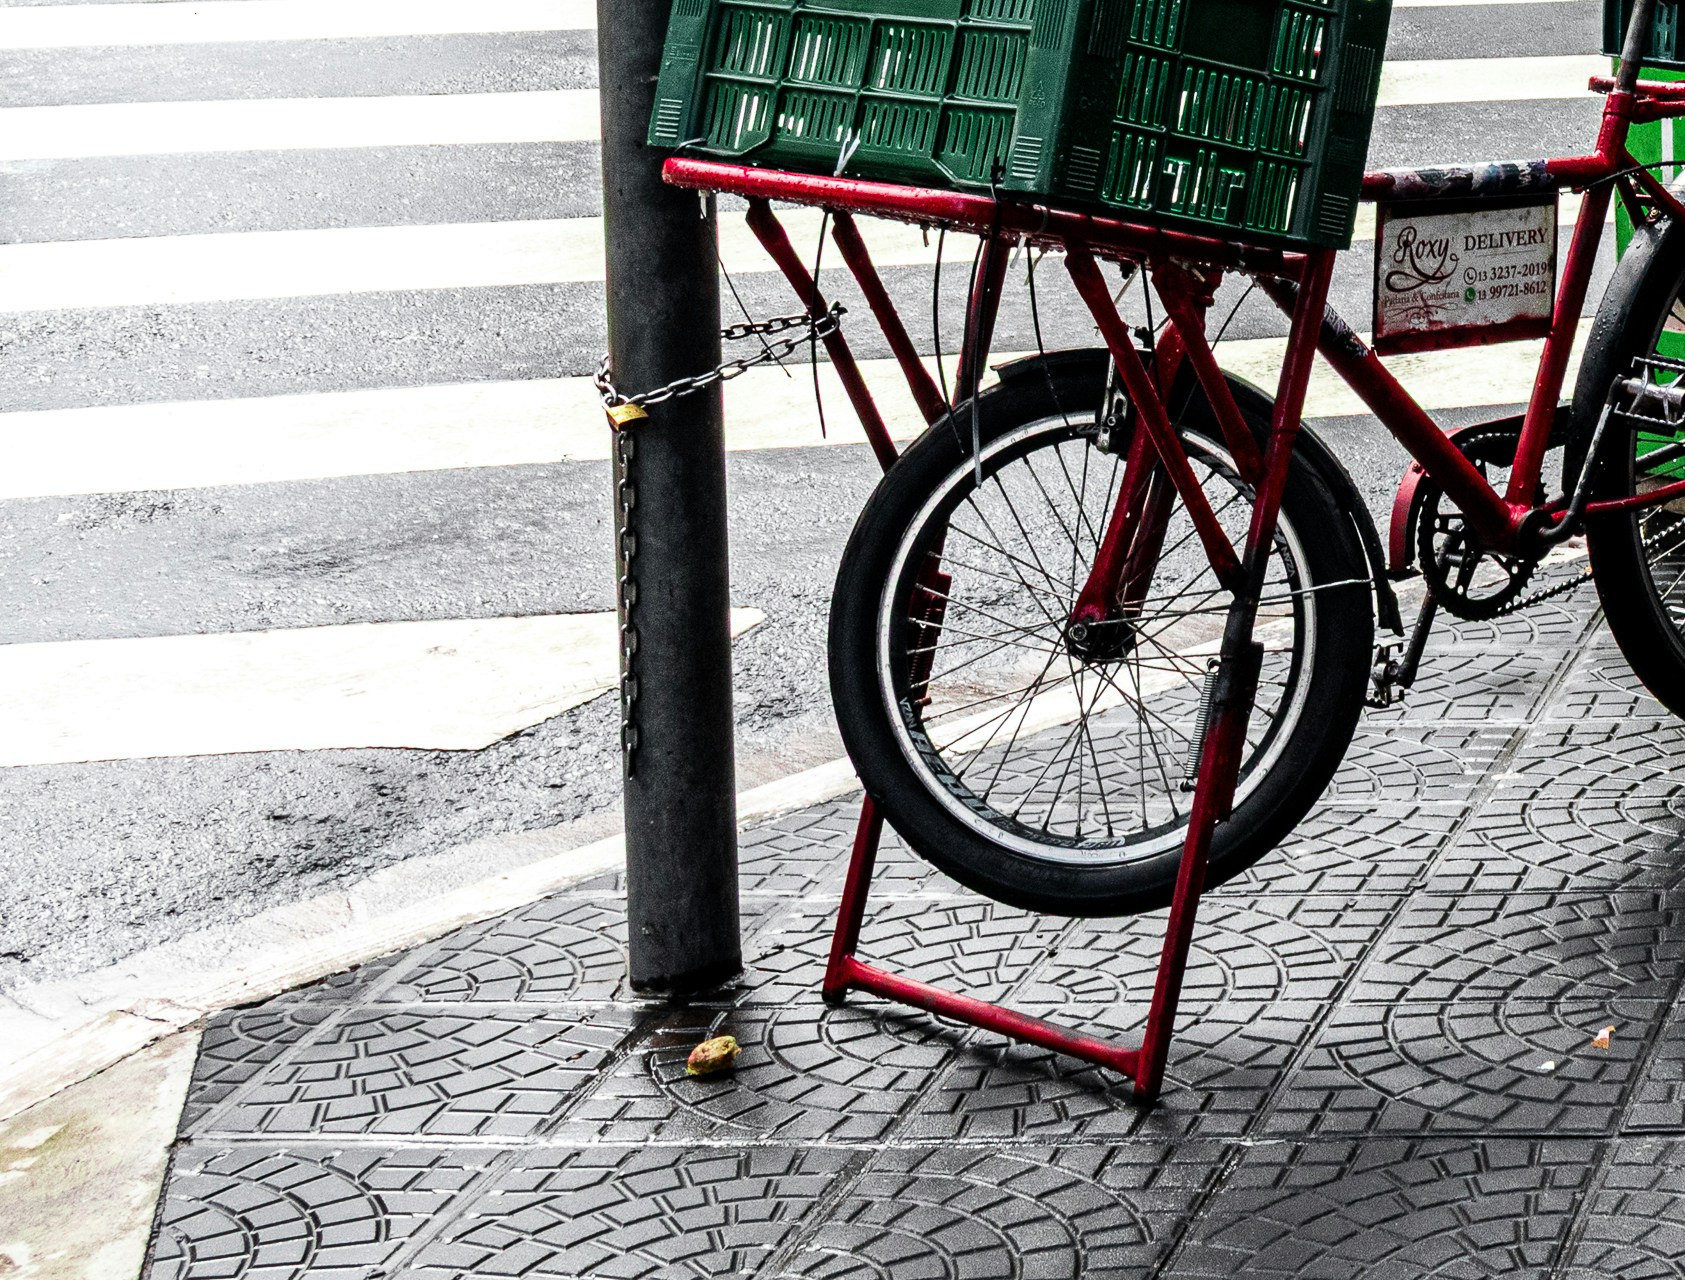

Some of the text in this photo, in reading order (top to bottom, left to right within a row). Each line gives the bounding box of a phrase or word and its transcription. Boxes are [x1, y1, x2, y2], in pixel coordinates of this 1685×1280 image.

[1463, 227, 1549, 252] DELIVERY
[1388, 225, 1457, 278] Roxy
[1478, 261, 1549, 283] 13 3237-2019
[1478, 280, 1548, 301] 13 99721-8612
